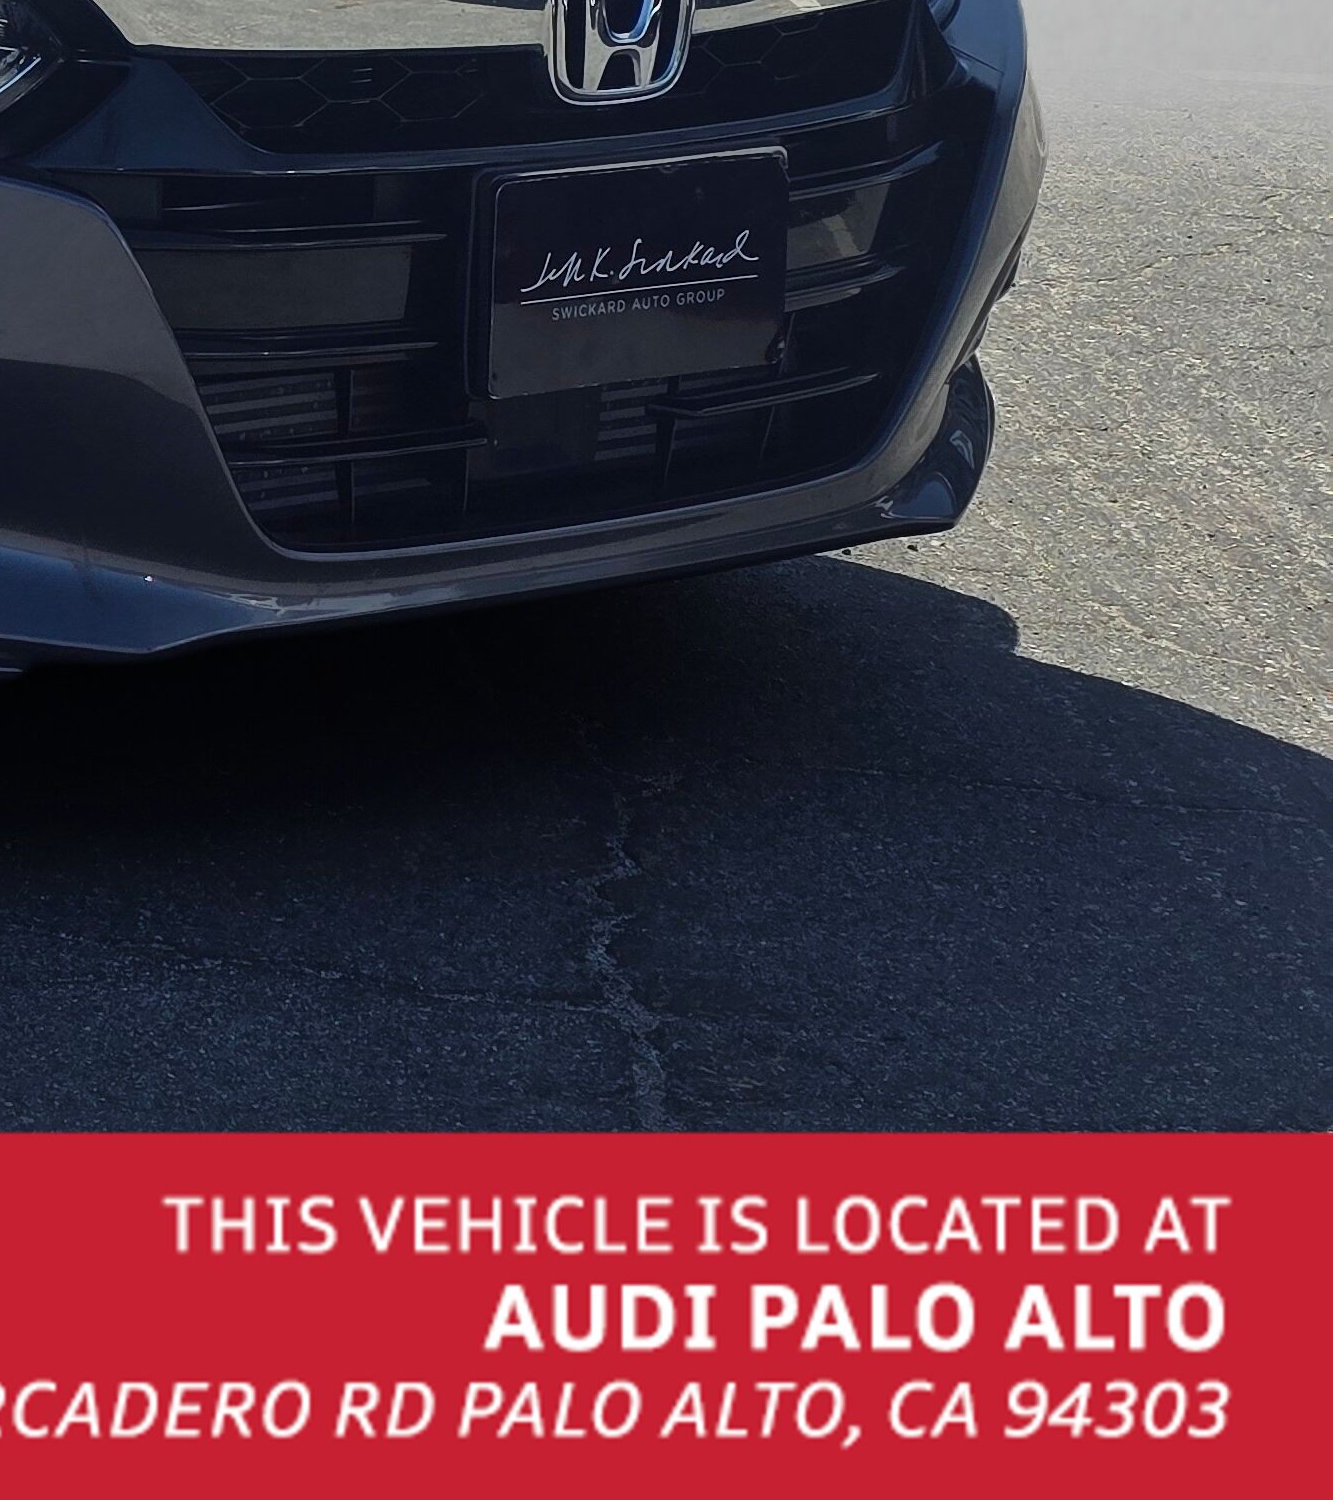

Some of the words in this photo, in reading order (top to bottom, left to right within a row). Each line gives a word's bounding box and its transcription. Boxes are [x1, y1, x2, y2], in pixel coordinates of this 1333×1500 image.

[551, 299, 626, 322] SWICKARD
[631, 293, 671, 312] AUTO
[675, 288, 726, 307] GROUP
